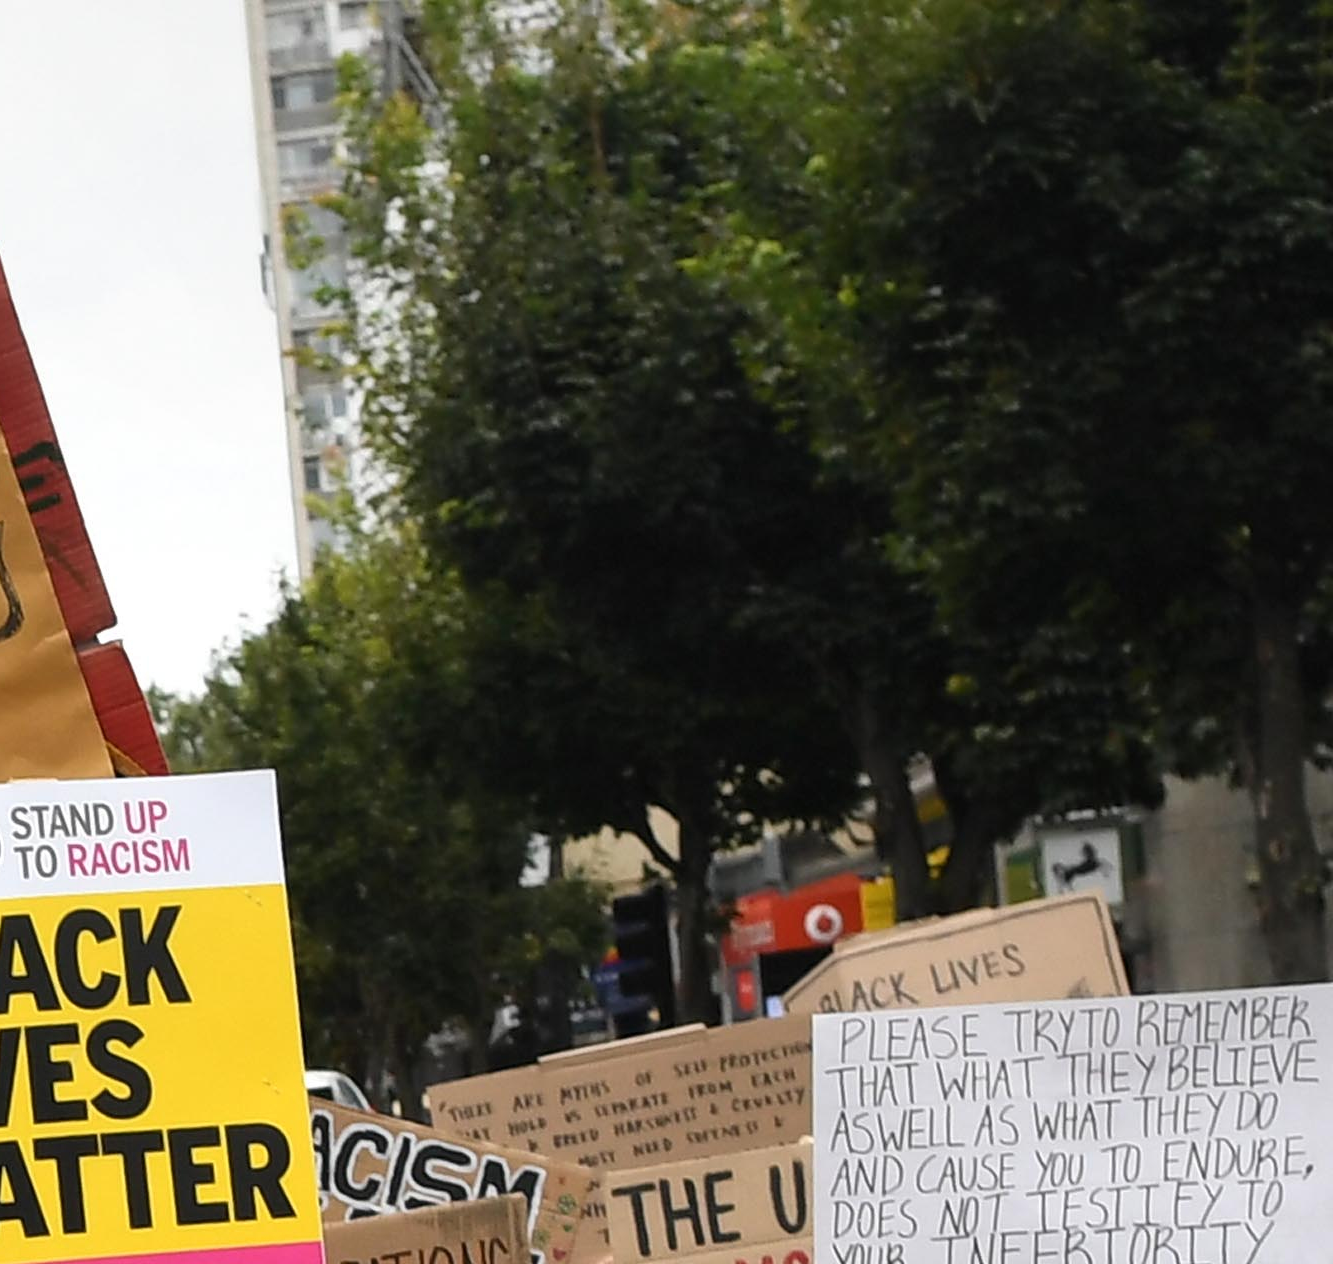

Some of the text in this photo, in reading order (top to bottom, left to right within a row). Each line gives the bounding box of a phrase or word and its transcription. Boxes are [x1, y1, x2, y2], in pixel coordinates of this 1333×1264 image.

[10, 801, 169, 840] STAND UP
[13, 838, 191, 879] TO RACISM
[932, 944, 1026, 996] LIVES
[841, 1015, 987, 1063] PLEASE
[1136, 995, 1311, 1047] REMEMBER
[512, 1093, 544, 1113] ARE
[635, 1072, 653, 1087] OF
[825, 1040, 1319, 1108] THAT WHAT THEY BELIEVE
[507, 1119, 547, 1138] HOLD
[688, 1081, 733, 1099] FROM
[751, 1069, 797, 1088] EACH
[975, 1104, 1019, 1146] AS
[1033, 1100, 1124, 1141] WHAT
[1134, 1092, 1226, 1137] THEY
[1236, 1091, 1278, 1131] DO
[633, 1139, 673, 1157] NEED
[831, 1136, 1314, 1197] AND CAUSE YOU TO ENDURE,
[611, 1170, 741, 1257] THE
[834, 1200, 918, 1239] DOES
[939, 1192, 1010, 1235] NOT
[1237, 1181, 1283, 1219] TO
